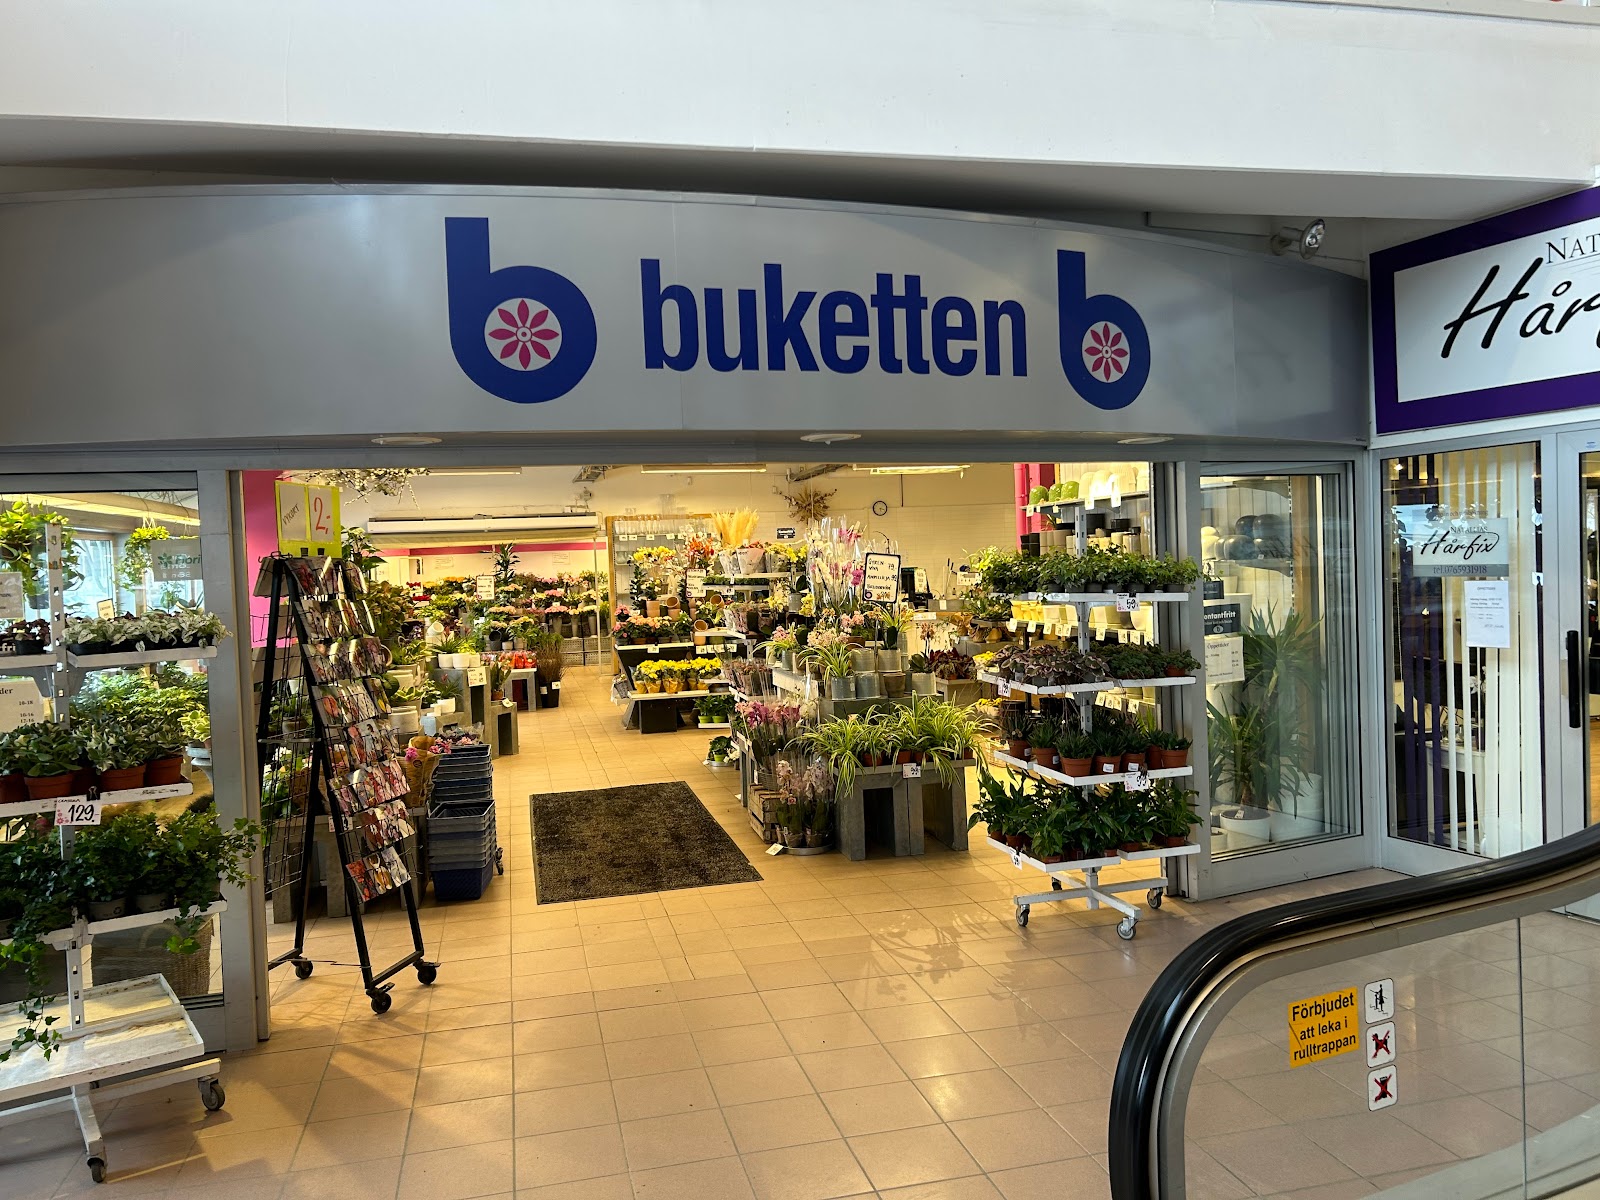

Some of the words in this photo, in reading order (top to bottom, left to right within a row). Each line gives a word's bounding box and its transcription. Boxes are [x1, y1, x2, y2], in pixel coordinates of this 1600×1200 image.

[641, 258, 1027, 377] buketten
[1441, 257, 1600, 358] Hår
[1420, 530, 1499, 560] Hårfix
[1292, 992, 1354, 1021] Förbjudet
[1300, 1026, 1315, 1041] att
[1318, 1020, 1341, 1035] leka
[1344, 1016, 1348, 1028] i
[1294, 1034, 1356, 1060] rulltrappan
